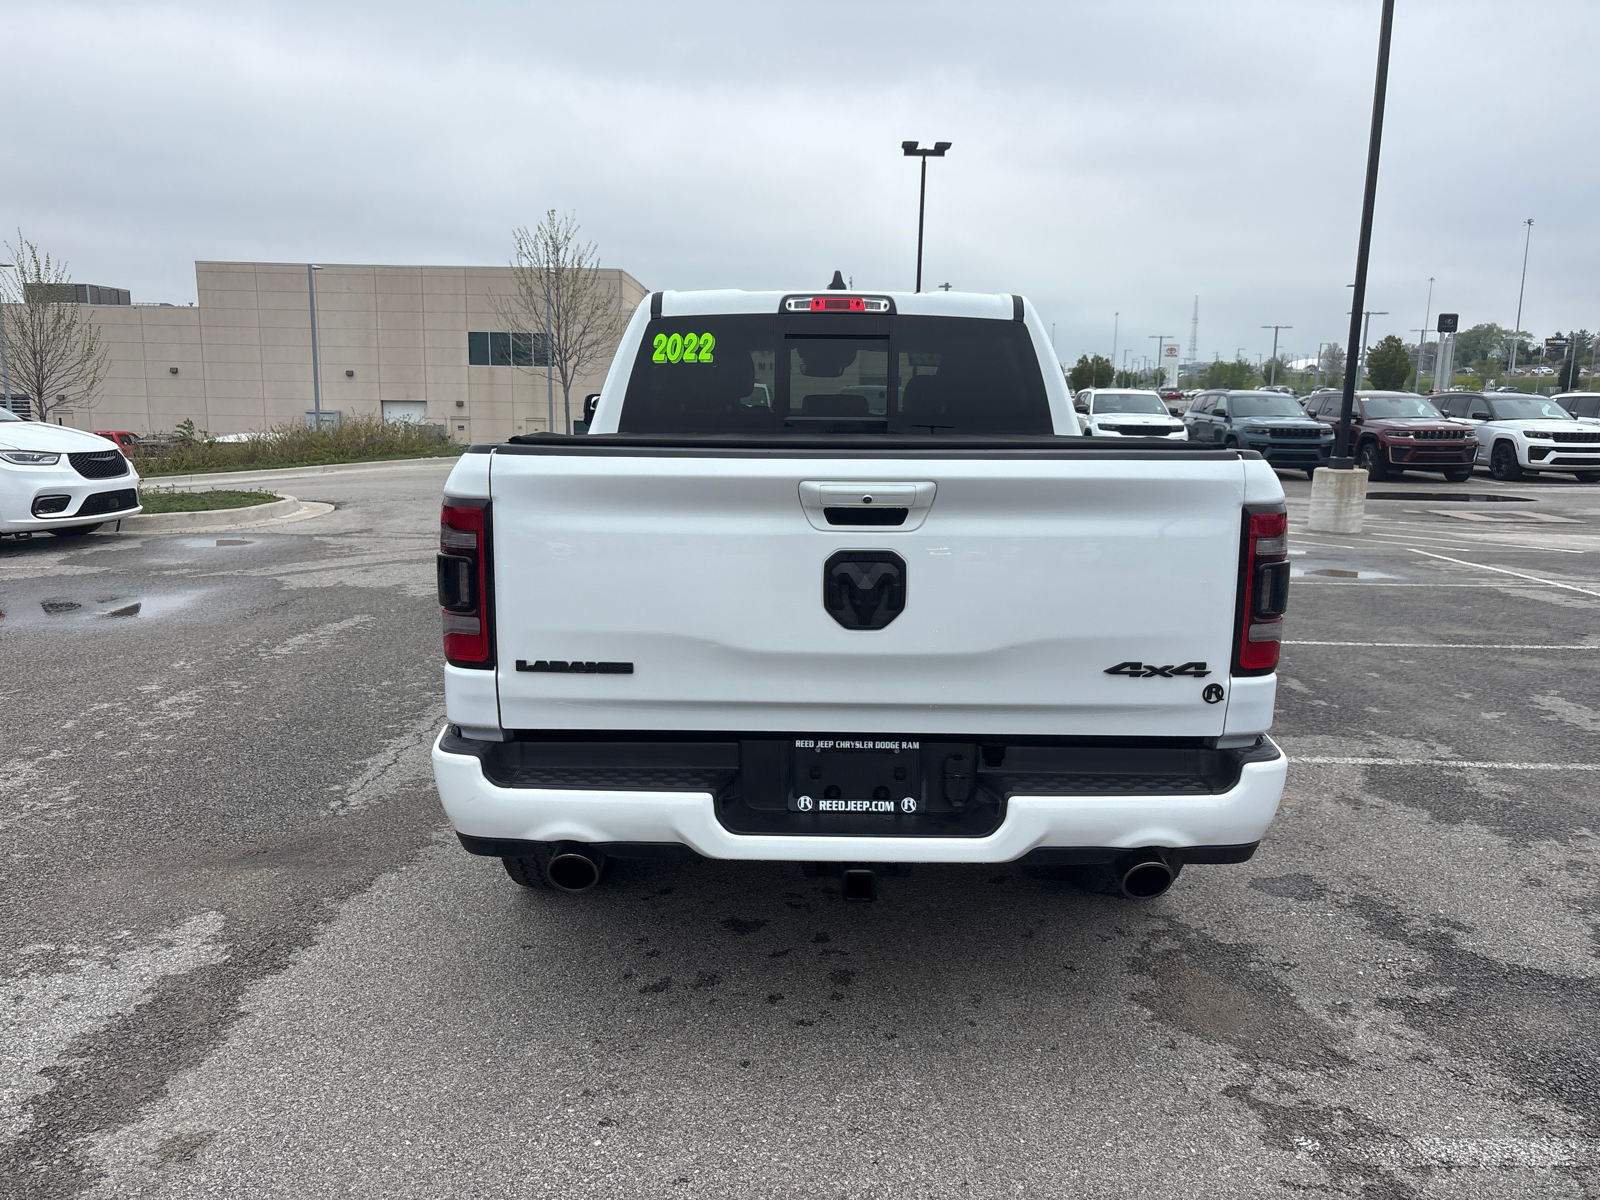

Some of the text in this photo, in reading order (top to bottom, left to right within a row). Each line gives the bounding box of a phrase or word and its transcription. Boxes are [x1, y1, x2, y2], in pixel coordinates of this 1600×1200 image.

[652, 332, 716, 364] 2022
[795, 739, 920, 750] REED JEEP CHRYSLER DODGE RAM
[819, 800, 895, 812] REEDJEEP.COM
